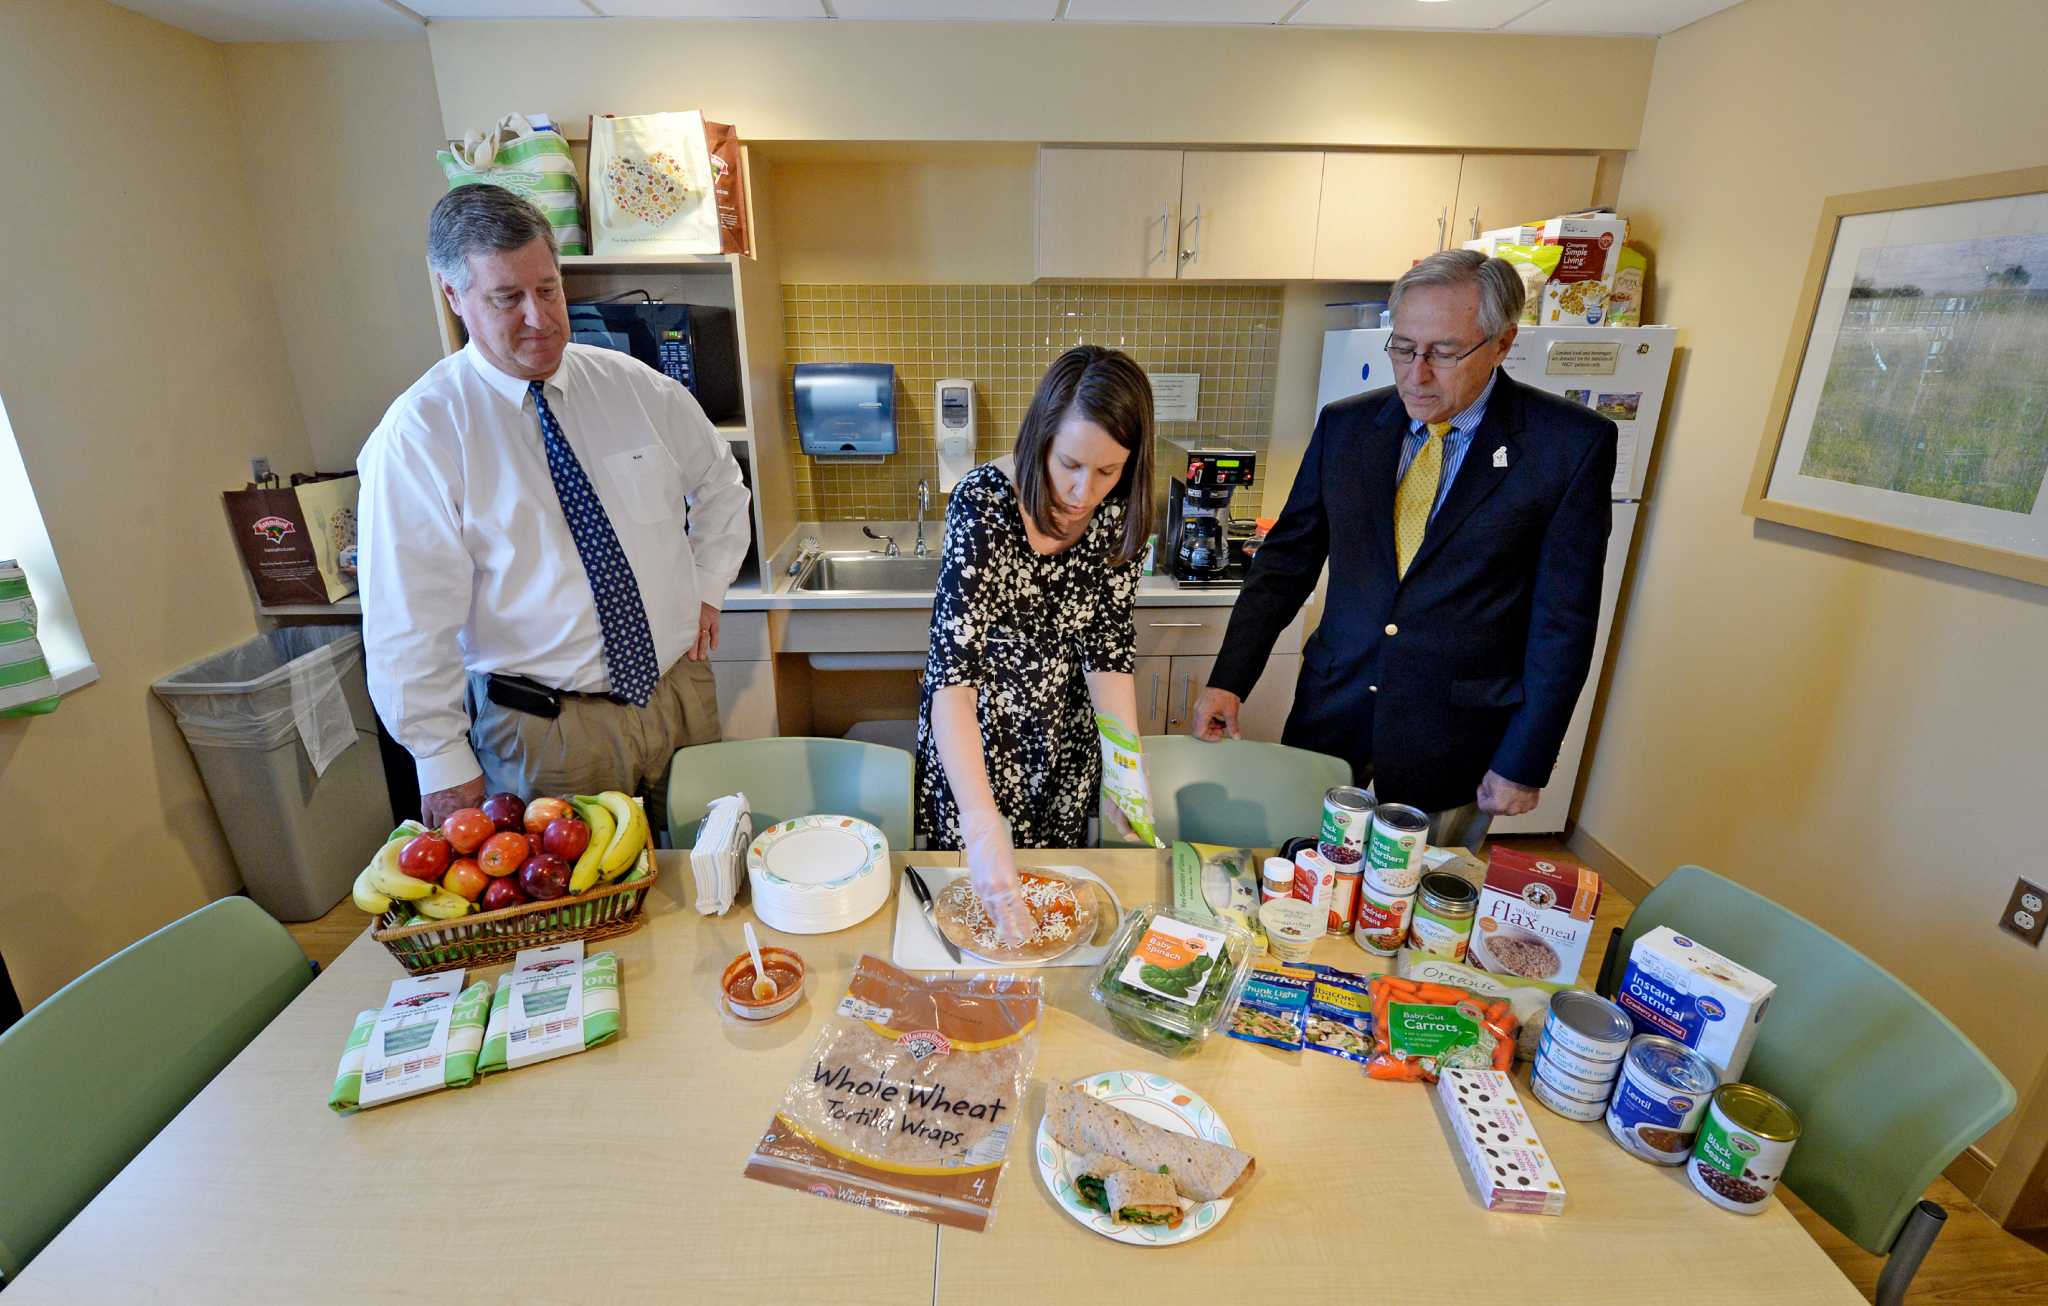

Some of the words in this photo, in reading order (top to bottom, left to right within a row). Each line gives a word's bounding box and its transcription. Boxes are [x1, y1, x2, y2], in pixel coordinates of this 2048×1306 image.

[1323, 818, 1337, 834] lack
[1372, 844, 1405, 864] Northern
[1373, 837, 1391, 852] Great
[1363, 903, 1388, 920] Refried
[1491, 899, 1538, 930] flax
[1541, 925, 1577, 941] meal
[1146, 943, 1181, 961] Spinach
[1150, 937, 1173, 950] Baby
[1423, 967, 1496, 991] Organic
[1247, 984, 1274, 997] hunk
[1315, 985, 1355, 1002] lbacore
[1632, 972, 1677, 1006] Instant
[1630, 984, 1685, 1022] Oatmeal
[1403, 1011, 1444, 1021] Baby-Cut
[1403, 1018, 1458, 1033] Carrots
[813, 1061, 898, 1102] Whole
[909, 1079, 1006, 1123] Wheat
[1625, 1086, 1652, 1110] Lentil
[827, 1099, 893, 1132] Tortilla
[901, 1114, 964, 1149] Wraps
[1707, 1132, 1732, 1160] Black
[1703, 1145, 1731, 1170] Beans
[972, 1178, 986, 1196] 4
